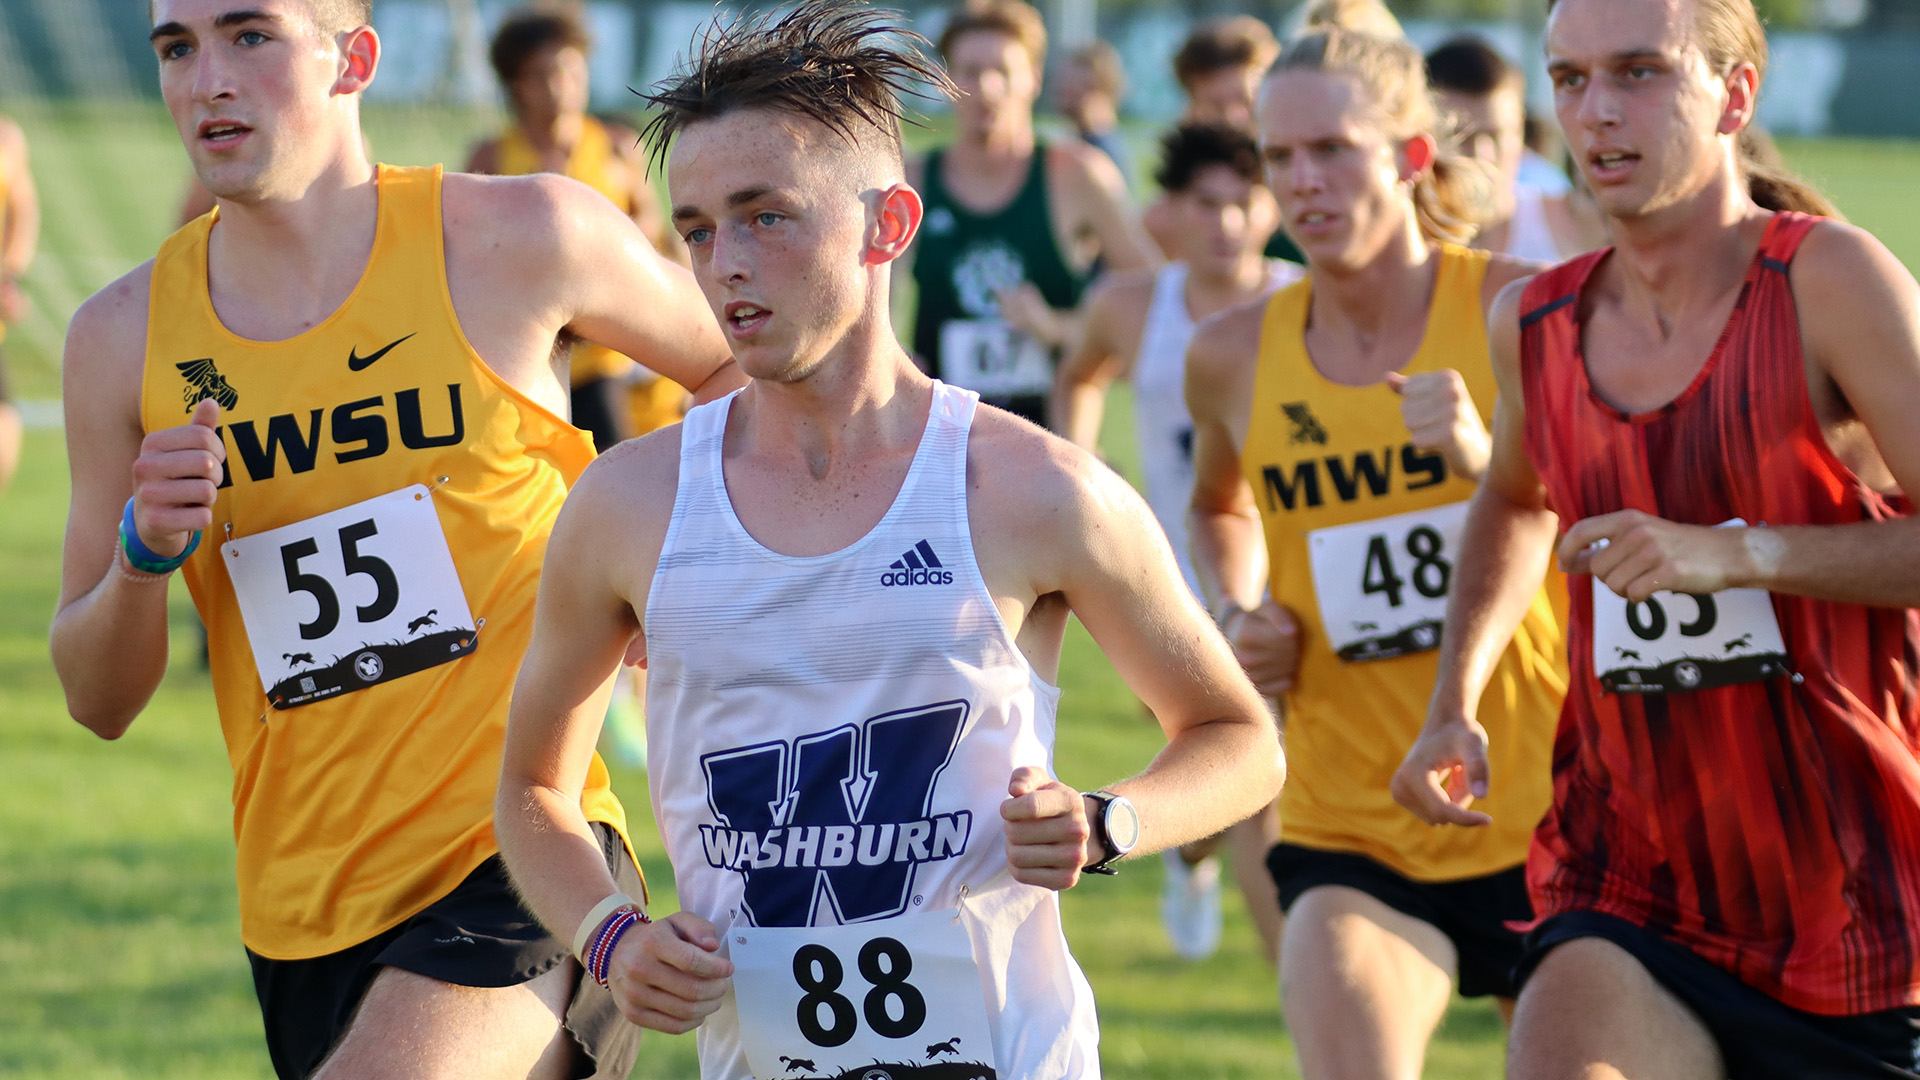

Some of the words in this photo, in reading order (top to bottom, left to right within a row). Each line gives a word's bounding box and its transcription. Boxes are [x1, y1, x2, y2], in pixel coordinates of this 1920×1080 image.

[217, 383, 465, 490] WSU
[281, 518, 399, 640] 55
[881, 567, 954, 587] adidas
[1363, 523, 1452, 608] 48
[698, 810, 973, 870] WASHBURN
[792, 936, 926, 1048] 88
